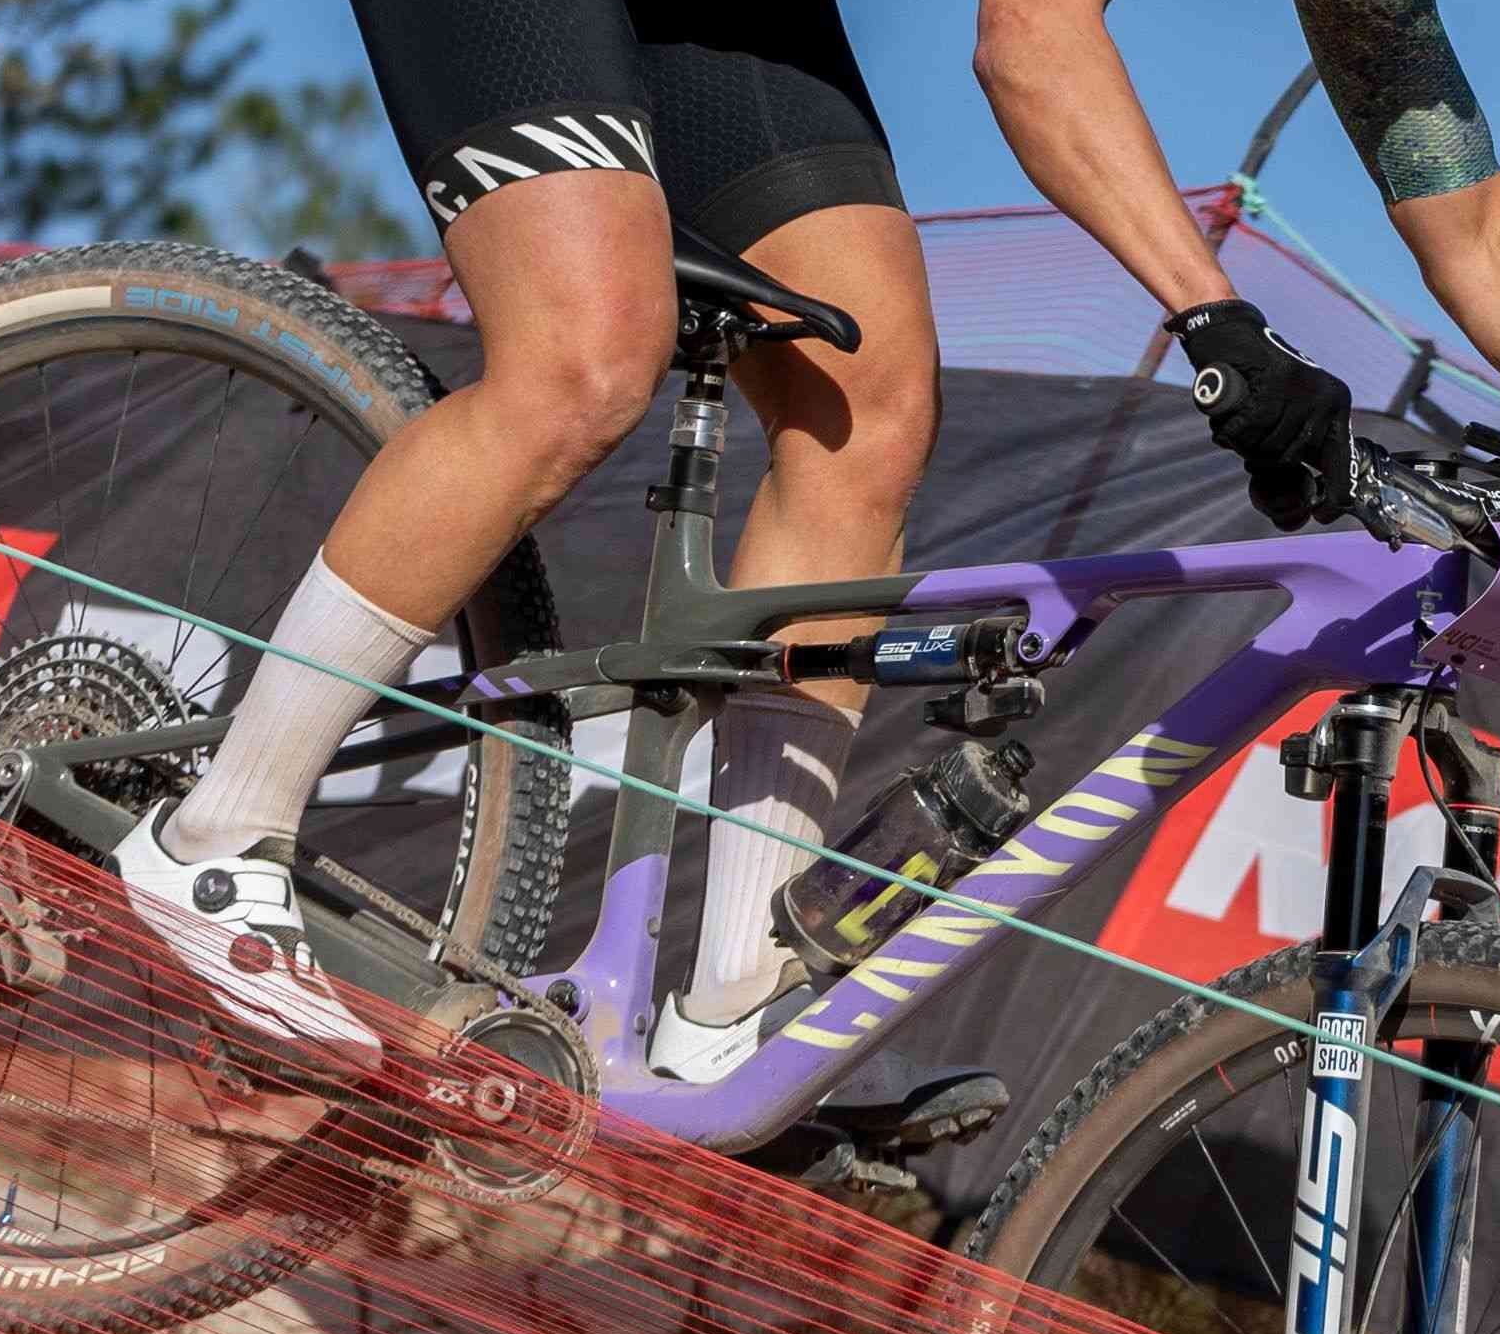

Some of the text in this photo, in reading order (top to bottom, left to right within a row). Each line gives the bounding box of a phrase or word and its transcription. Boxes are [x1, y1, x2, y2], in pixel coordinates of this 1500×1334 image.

[125, 286, 372, 411] FIRST RIDE
[914, 639, 956, 653] LUXE
[781, 733, 1217, 1050] CANYON
[1321, 1016, 1363, 1045] ROCK
[1317, 1047, 1360, 1073] SHOX
